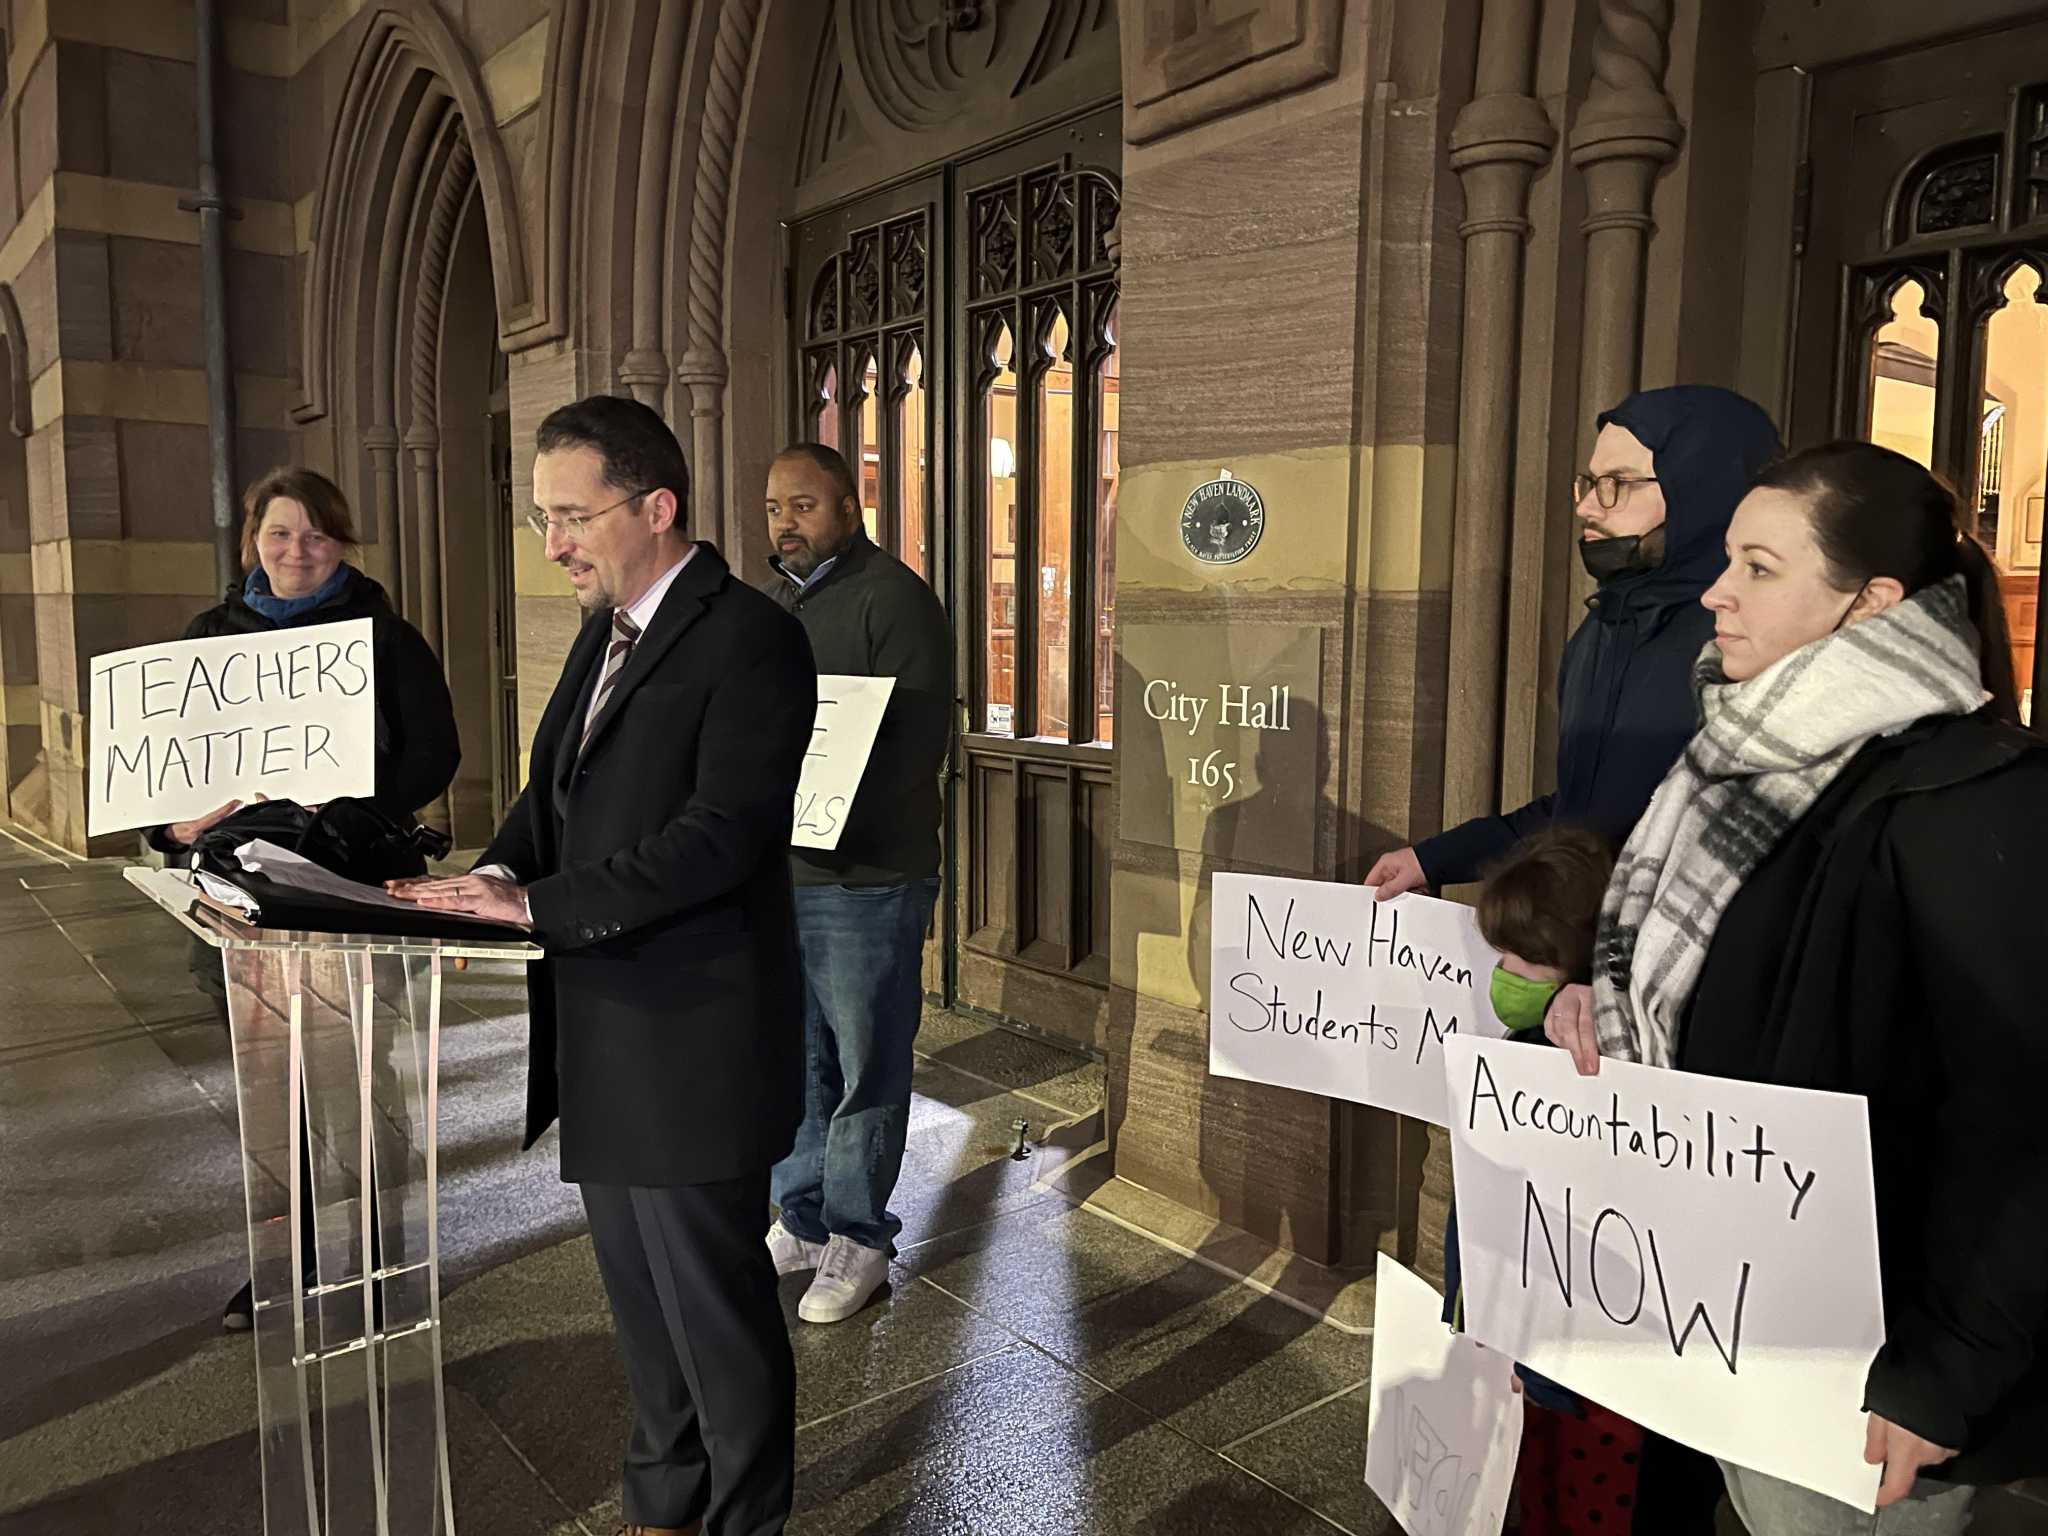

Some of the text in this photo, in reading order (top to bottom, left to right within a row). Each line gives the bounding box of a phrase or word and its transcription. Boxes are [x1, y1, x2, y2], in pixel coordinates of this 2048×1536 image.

[1184, 496, 1199, 519] NEW
[1199, 483, 1225, 502] HAVEN
[1226, 482, 1261, 526] LANDMARK
[95, 639, 369, 730] TEACHERS
[1143, 679, 1291, 736] City Hall
[105, 723, 341, 804] MATTER
[1187, 749, 1237, 800] 165
[1246, 892, 1473, 989] New Haven
[1228, 971, 1400, 1051] Students
[1468, 1053, 1817, 1221] Accountability
[1521, 1179, 1752, 1376] NOW
